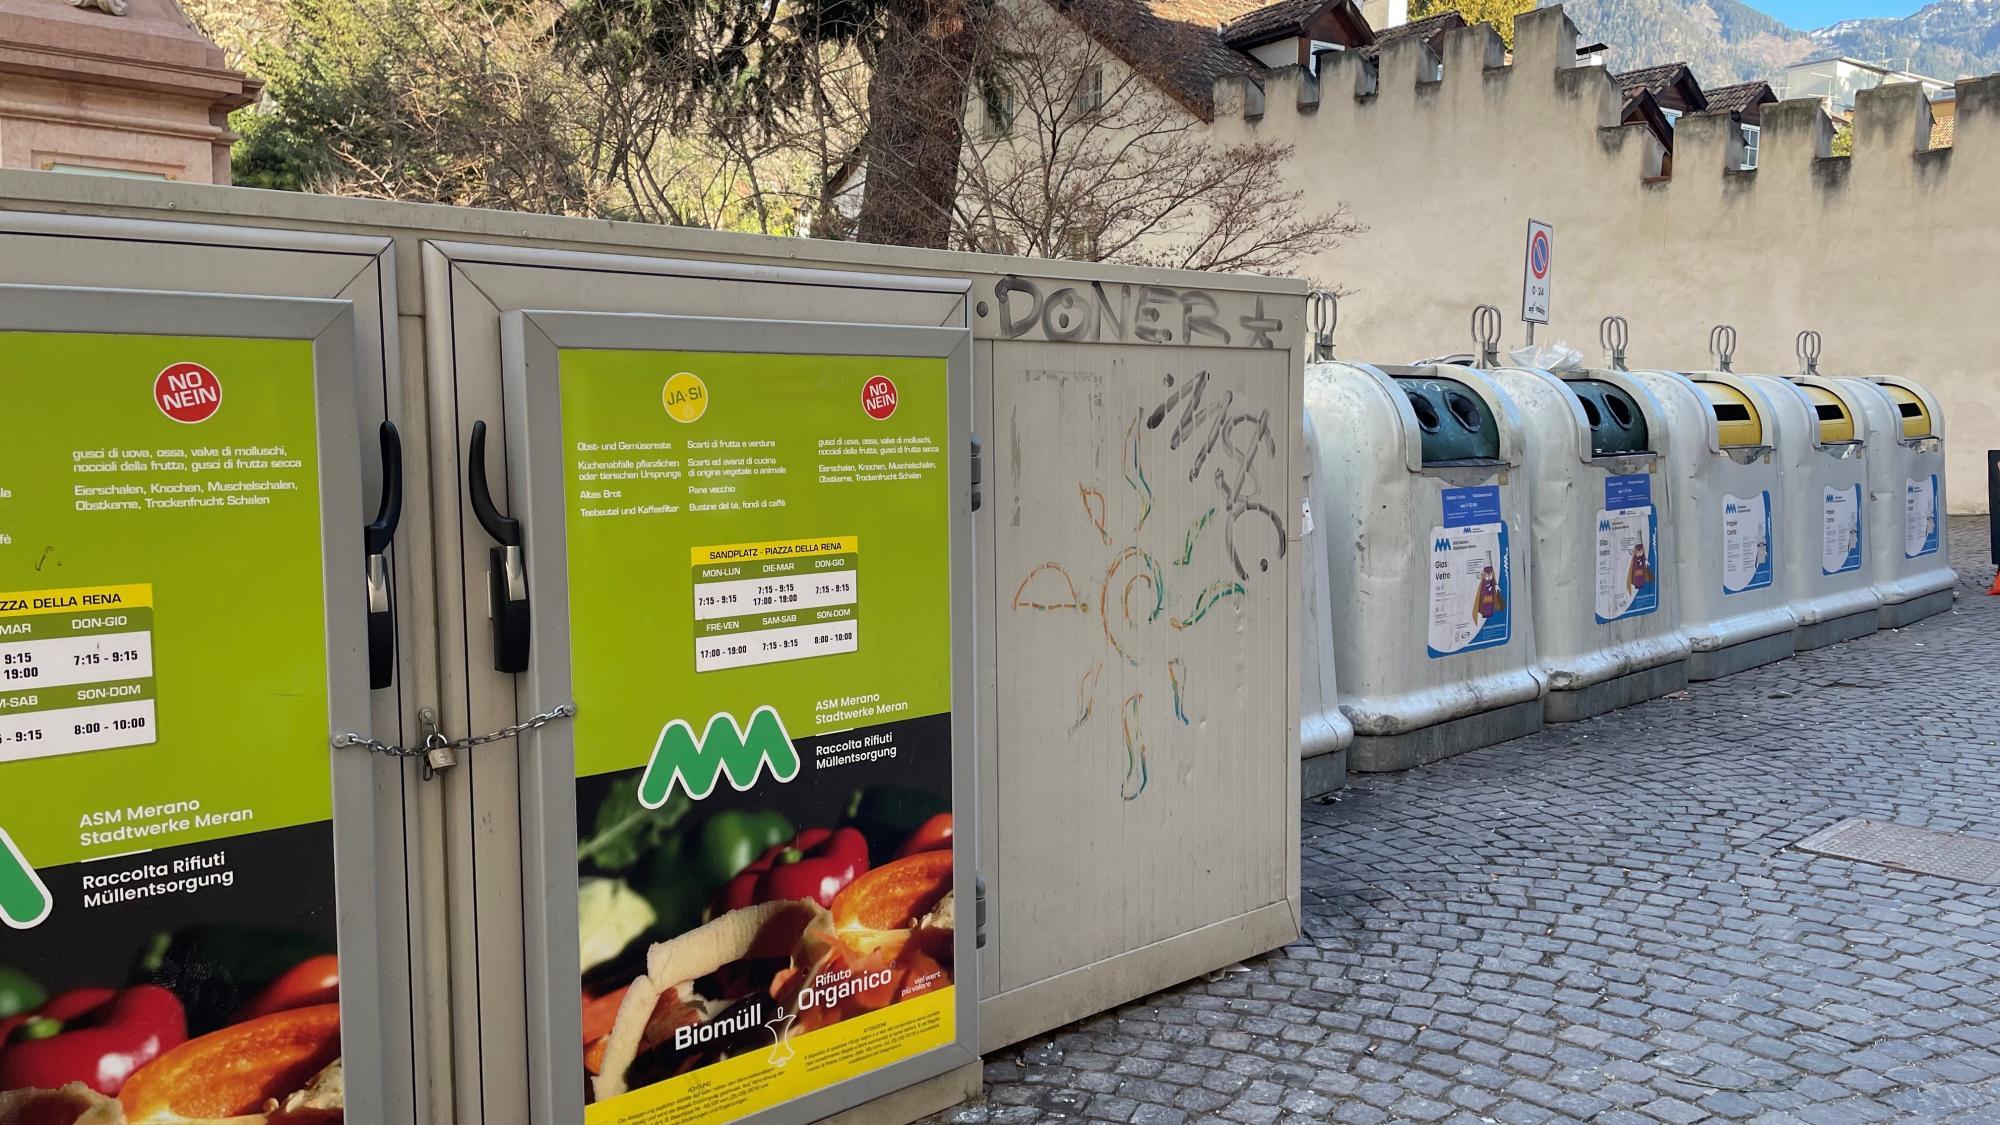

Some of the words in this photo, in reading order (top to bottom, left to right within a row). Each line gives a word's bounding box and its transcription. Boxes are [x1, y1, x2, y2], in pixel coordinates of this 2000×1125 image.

[168, 371, 202, 391] NO
[869, 382, 888, 397] NO
[163, 386, 217, 411] NEIN
[866, 393, 896, 412] NEIN
[577, 442, 599, 451] Obst-
[602, 442, 617, 450] und
[618, 441, 672, 450] Gemüsereste
[687, 440, 709, 449] Scarti
[712, 440, 718, 448] di
[720, 440, 740, 448] frutta
[748, 440, 776, 448] verdura
[818, 439, 835, 447] gusci
[837, 438, 842, 446] di
[73, 448, 104, 461] gusci
[108, 448, 118, 458] di
[122, 450, 152, 459] uova,
[157, 449, 187, 459] ossa,
[191, 447, 218, 457] valve
[222, 446, 232, 456] di
[235, 446, 287, 457] molluschi,
[73, 462, 117, 473] noccioli
[121, 461, 147, 472] della
[151, 461, 187, 472] frutta,
[192, 460, 221, 472] gusci
[224, 459, 233, 469] di
[236, 459, 268, 469] frutta
[271, 459, 302, 468] secca
[636, 459, 680, 469] pflanzlichen
[688, 458, 710, 467] Scarti
[712, 458, 721, 466] ed
[723, 457, 745, 465] avanzi
[746, 457, 752, 465] di
[579, 471, 598, 480] oder
[640, 470, 681, 480] Ursprungs
[688, 468, 695, 477] di
[697, 468, 721, 478] origine
[722, 467, 752, 477] vegetale
[760, 466, 786, 474] animale
[898, 472, 922, 480] Schalen
[75, 484, 146, 496] Eierschalen,
[151, 482, 204, 494] Knochen,
[208, 481, 298, 492] Muschelschalen,
[580, 490, 601, 499] Altes
[603, 489, 622, 498] Brot
[688, 486, 708, 494] Pane
[709, 485, 736, 493] vecchio
[75, 500, 141, 511] Obstkerne,
[145, 496, 224, 508] Trockenfrucht
[227, 495, 270, 506] Schalen
[689, 503, 717, 511] Bustine
[743, 500, 759, 508] fondi
[761, 500, 767, 508] di
[580, 508, 618, 517] Teebeutel
[621, 506, 636, 515] und
[637, 505, 680, 514] Kaffeefilter
[709, 548, 758, 560] SANDPLATZ
[765, 545, 793, 556] PIAZZA
[795, 543, 819, 553] DELLA
[821, 542, 842, 551] RENA
[762, 563, 795, 573] DIE-MAR
[815, 558, 845, 568] DON-GIO
[1435, 561, 1448, 569] Glas
[702, 567, 741, 578] MON-LUN
[1435, 572, 1451, 580] Vetro
[758, 585, 773, 595] 7:15
[779, 583, 794, 593] 9:15
[815, 585, 830, 594] 7:15
[835, 583, 850, 593] 9:15
[33, 596, 78, 609] DELLA
[82, 593, 122, 605] RENA
[699, 597, 715, 606] 7:15
[721, 595, 737, 604] 9:15
[753, 597, 772, 606] 17:00
[778, 594, 798, 604] 19:00
[762, 615, 797, 625] SAM-SAB
[816, 608, 851, 619] SON-DOM
[72, 616, 128, 630] DON-GIO
[706, 621, 740, 632] FRE-VEN
[814, 635, 829, 644] 8:00
[835, 632, 852, 642] 10:00
[762, 641, 777, 651] 7:15
[783, 639, 798, 648] 9:15
[4, 652, 32, 665] 9:15
[74, 653, 100, 666] 7:15
[112, 650, 138, 662] 9:15
[700, 649, 721, 659] 17:00
[727, 646, 747, 655] 19:00
[3, 667, 39, 680] 19:00
[77, 685, 141, 700] SON-DOM
[816, 699, 838, 711] ASM
[840, 693, 880, 707] Merano
[816, 707, 874, 724] Stadtwerke
[877, 701, 908, 714] Meran
[74, 723, 100, 735] 8:00
[113, 717, 145, 730] 10:00
[15, 729, 43, 742] 9:15
[816, 740, 862, 756] Raccolta
[864, 732, 893, 747] Rifiuti
[816, 746, 897, 770] Müllentsorgung
[79, 809, 122, 828] ASM
[127, 800, 200, 821] Merano
[80, 817, 190, 847] Stadtwerke
[195, 808, 254, 830] Meran
[83, 864, 168, 890] Raccolta
[173, 851, 226, 873] Rifiuti
[83, 869, 234, 909] Müllentsorgung
[815, 969, 852, 988] Rifiuto
[926, 971, 941, 981] wert
[798, 969, 892, 1010] Organico
[675, 1003, 761, 1051] Biomüll
